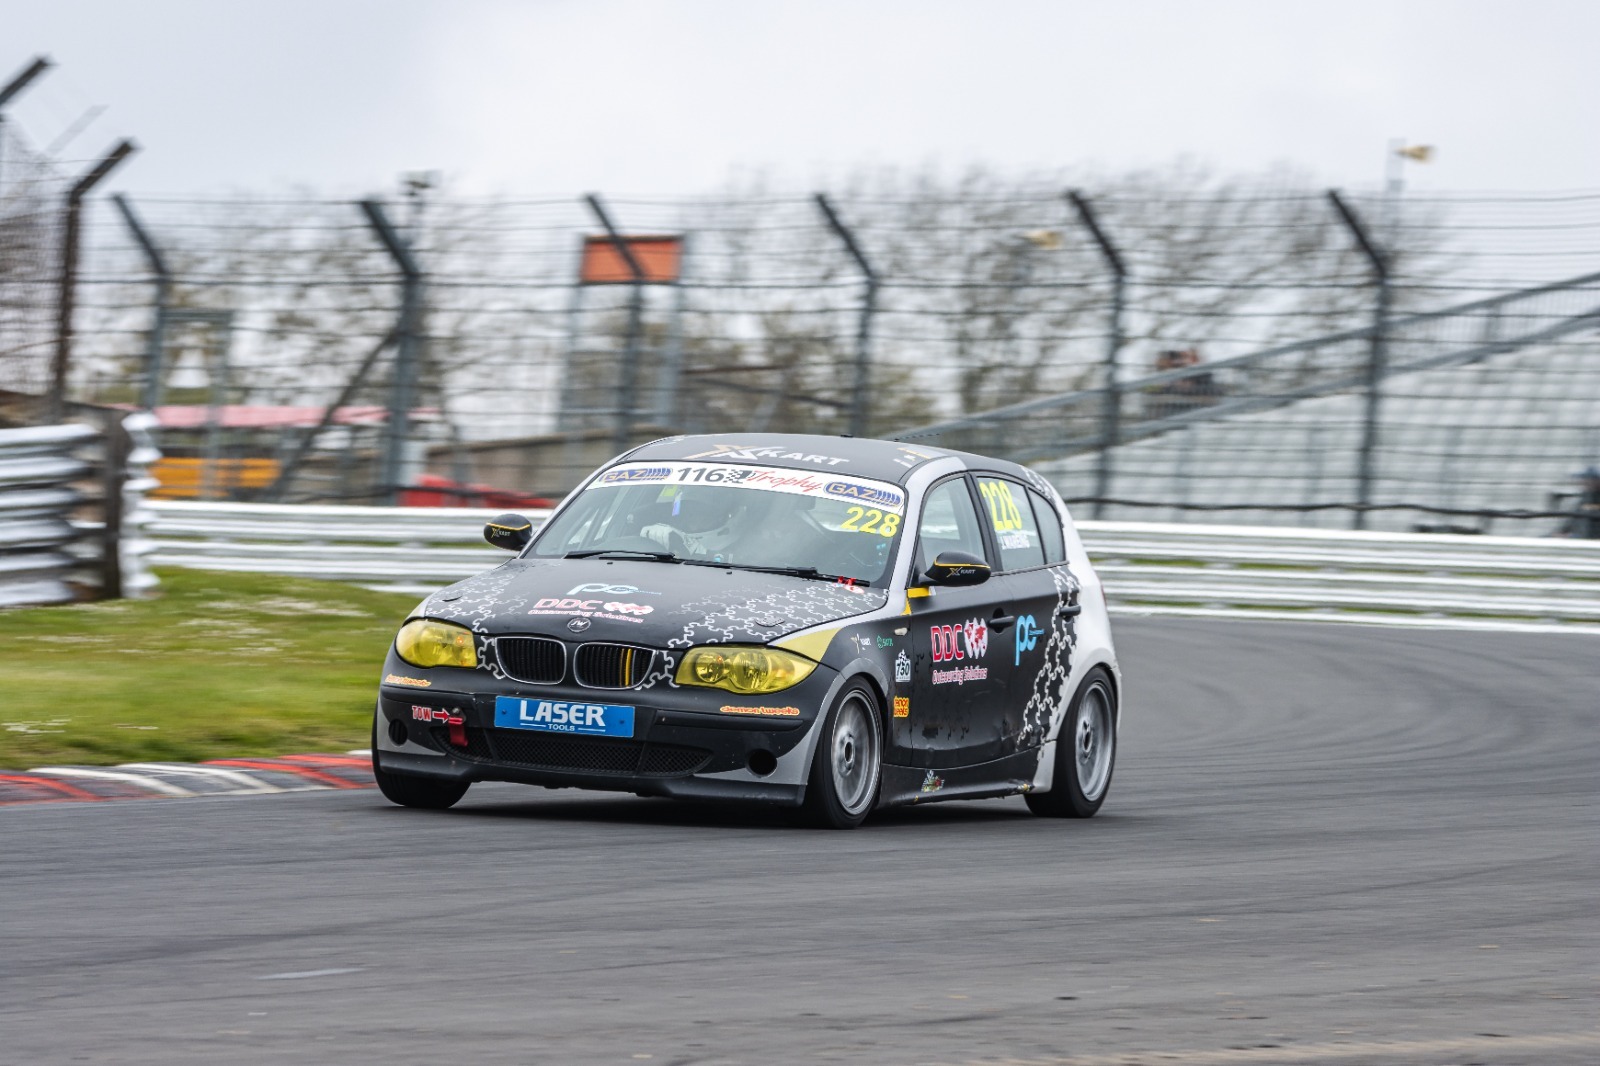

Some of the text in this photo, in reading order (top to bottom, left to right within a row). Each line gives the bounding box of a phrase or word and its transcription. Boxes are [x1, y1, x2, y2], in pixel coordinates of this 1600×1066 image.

[603, 468, 647, 483] GAZ
[678, 467, 822, 492] 116 Trophy
[828, 483, 877, 500] GAZ
[979, 481, 1022, 531] 228
[840, 506, 900, 537] 228
[533, 599, 603, 609] DDC
[930, 623, 965, 662] DDC
[932, 665, 988, 685] Outsourcing Solutions
[411, 705, 432, 722] TOW
[520, 700, 606, 726] LASER
